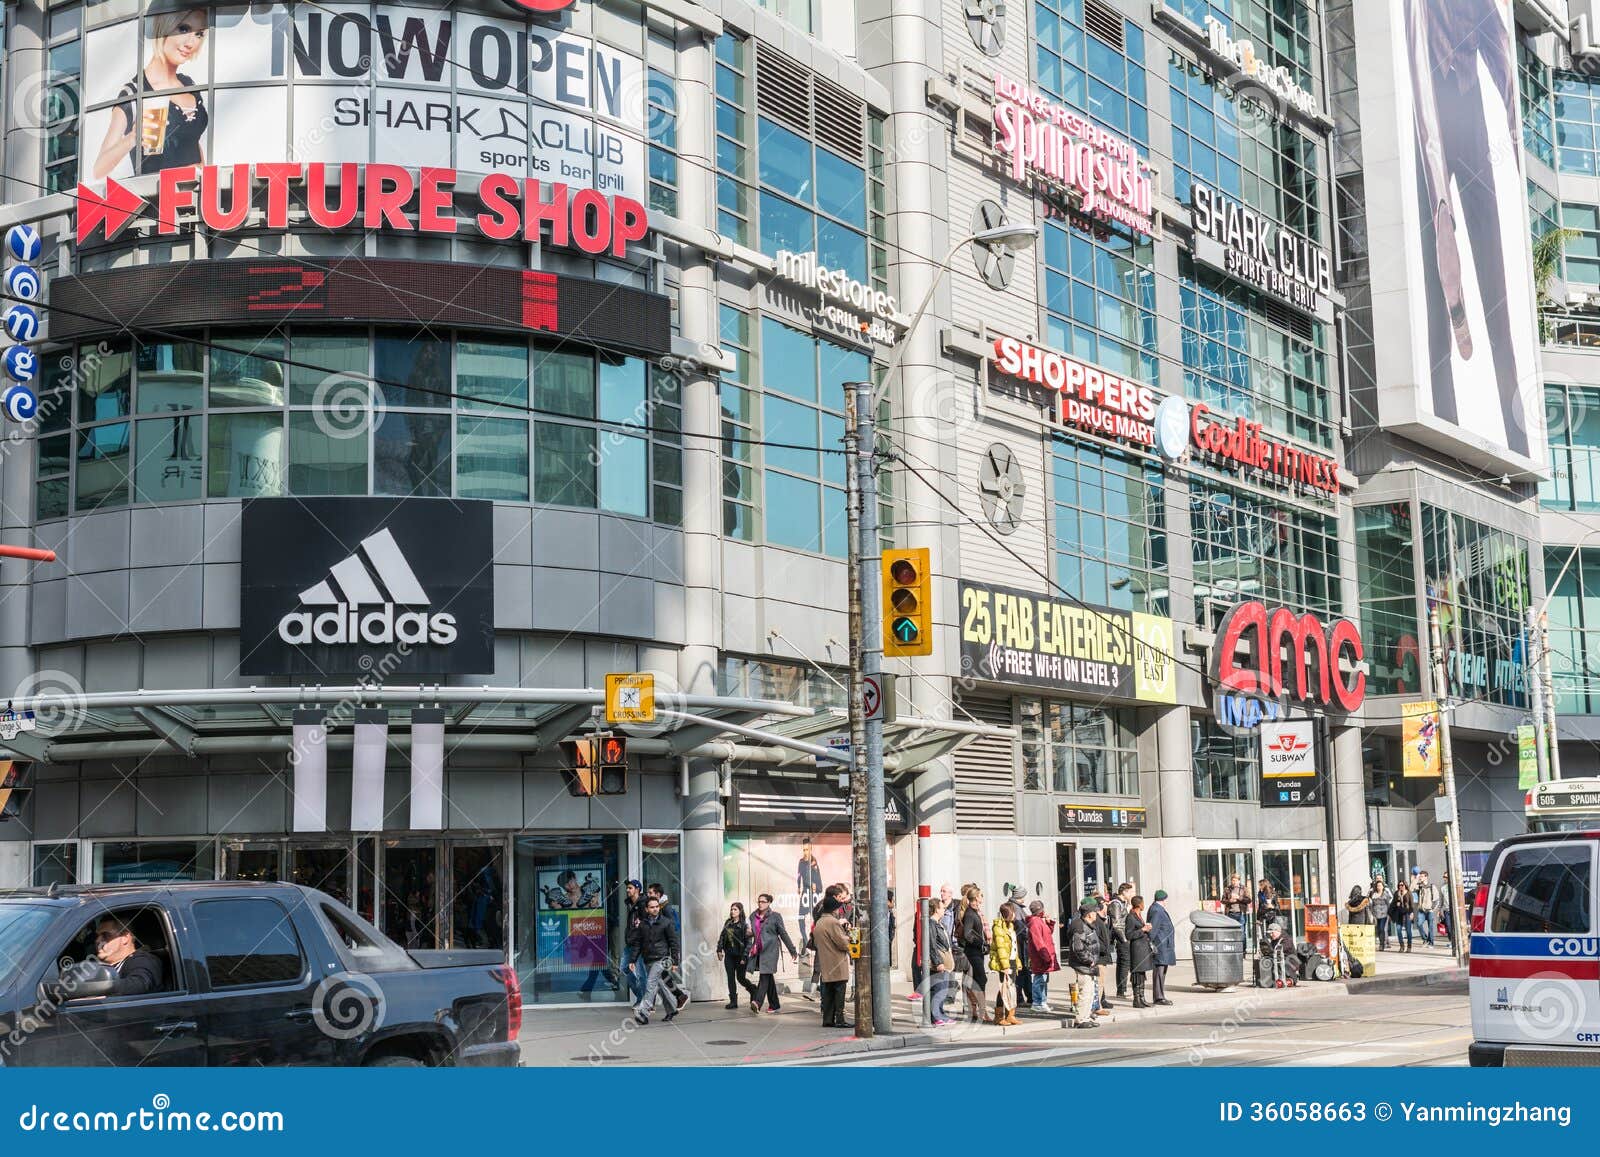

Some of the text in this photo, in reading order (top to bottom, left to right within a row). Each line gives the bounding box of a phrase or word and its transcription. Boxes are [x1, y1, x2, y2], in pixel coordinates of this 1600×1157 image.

[271, 8, 623, 118] NOW OPEN
[334, 97, 624, 165] SHARK CLUB
[480, 150, 624, 192] sports bar grill
[158, 162, 649, 258] FUTURE SHOP
[1192, 183, 1331, 296] SHARK CLUB
[777, 250, 897, 320] milestones
[1225, 248, 1267, 286] SPORTS
[1270, 268, 1291, 296] BAR
[5, 223, 41, 423] Yonge
[827, 306, 895, 346] GRILL BAR
[996, 337, 1156, 421] SHOPPERS
[1067, 397, 1157, 446] DRUG MART
[1271, 442, 1341, 495] FITNESS
[278, 602, 458, 645] adidas
[963, 587, 1132, 666] 25 FAB EATERIES!
[614, 676, 644, 685] PRIORITY
[1005, 649, 1033, 676] FREE
[1064, 660, 1079, 683] ON
[1081, 660, 1110, 686] LEVEL
[1112, 666, 1119, 688] 3
[1143, 663, 1166, 682] EAST
[613, 710, 647, 719] CROSSING
[1270, 753, 1306, 763] SUBWAY
[1077, 809, 1104, 823] Dundas
[1540, 795, 1556, 806] 505
